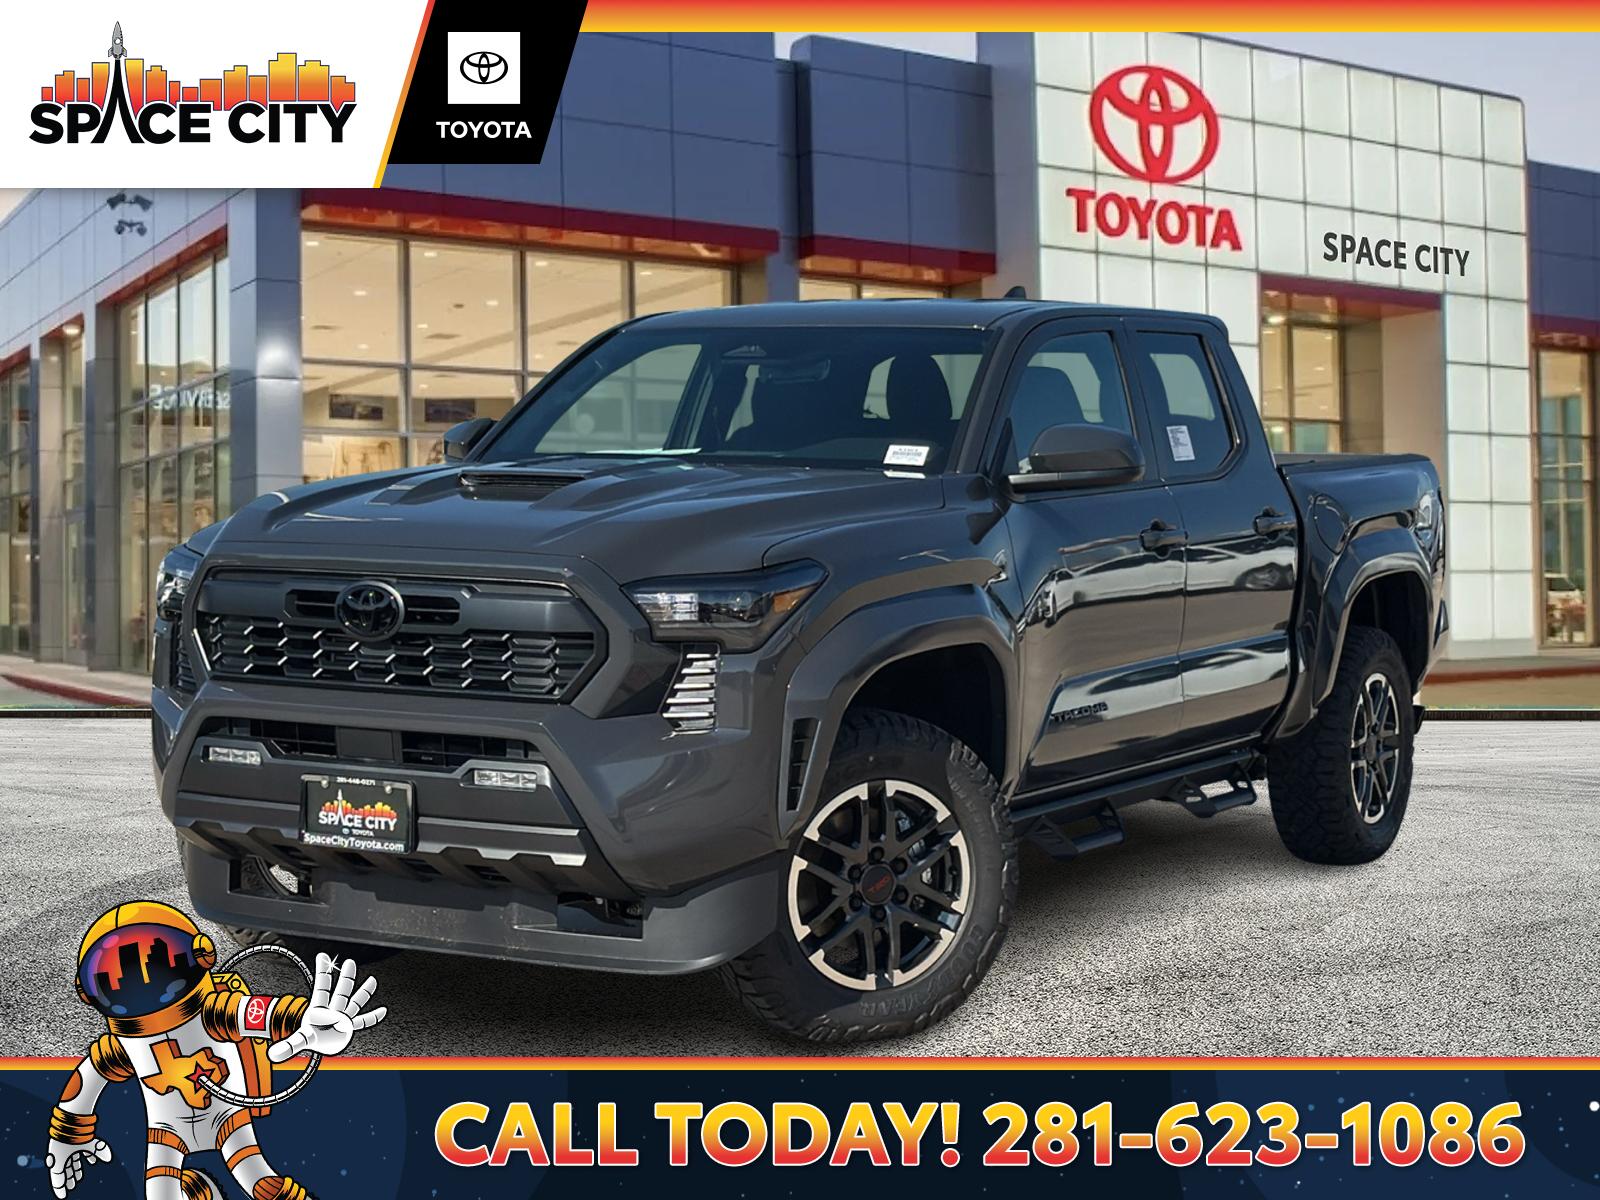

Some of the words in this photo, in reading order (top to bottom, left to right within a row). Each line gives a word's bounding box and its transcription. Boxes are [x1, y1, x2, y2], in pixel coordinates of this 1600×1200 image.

[1066, 188, 1242, 251] TOYOTA
[1323, 232, 1407, 270] SPACE
[1415, 244, 1470, 276] CITY
[319, 803, 363, 827] SPACE
[365, 816, 397, 832] CITY
[303, 833, 405, 852] SpaceCityToyota.com
[352, 829, 374, 837] TOYOTA
